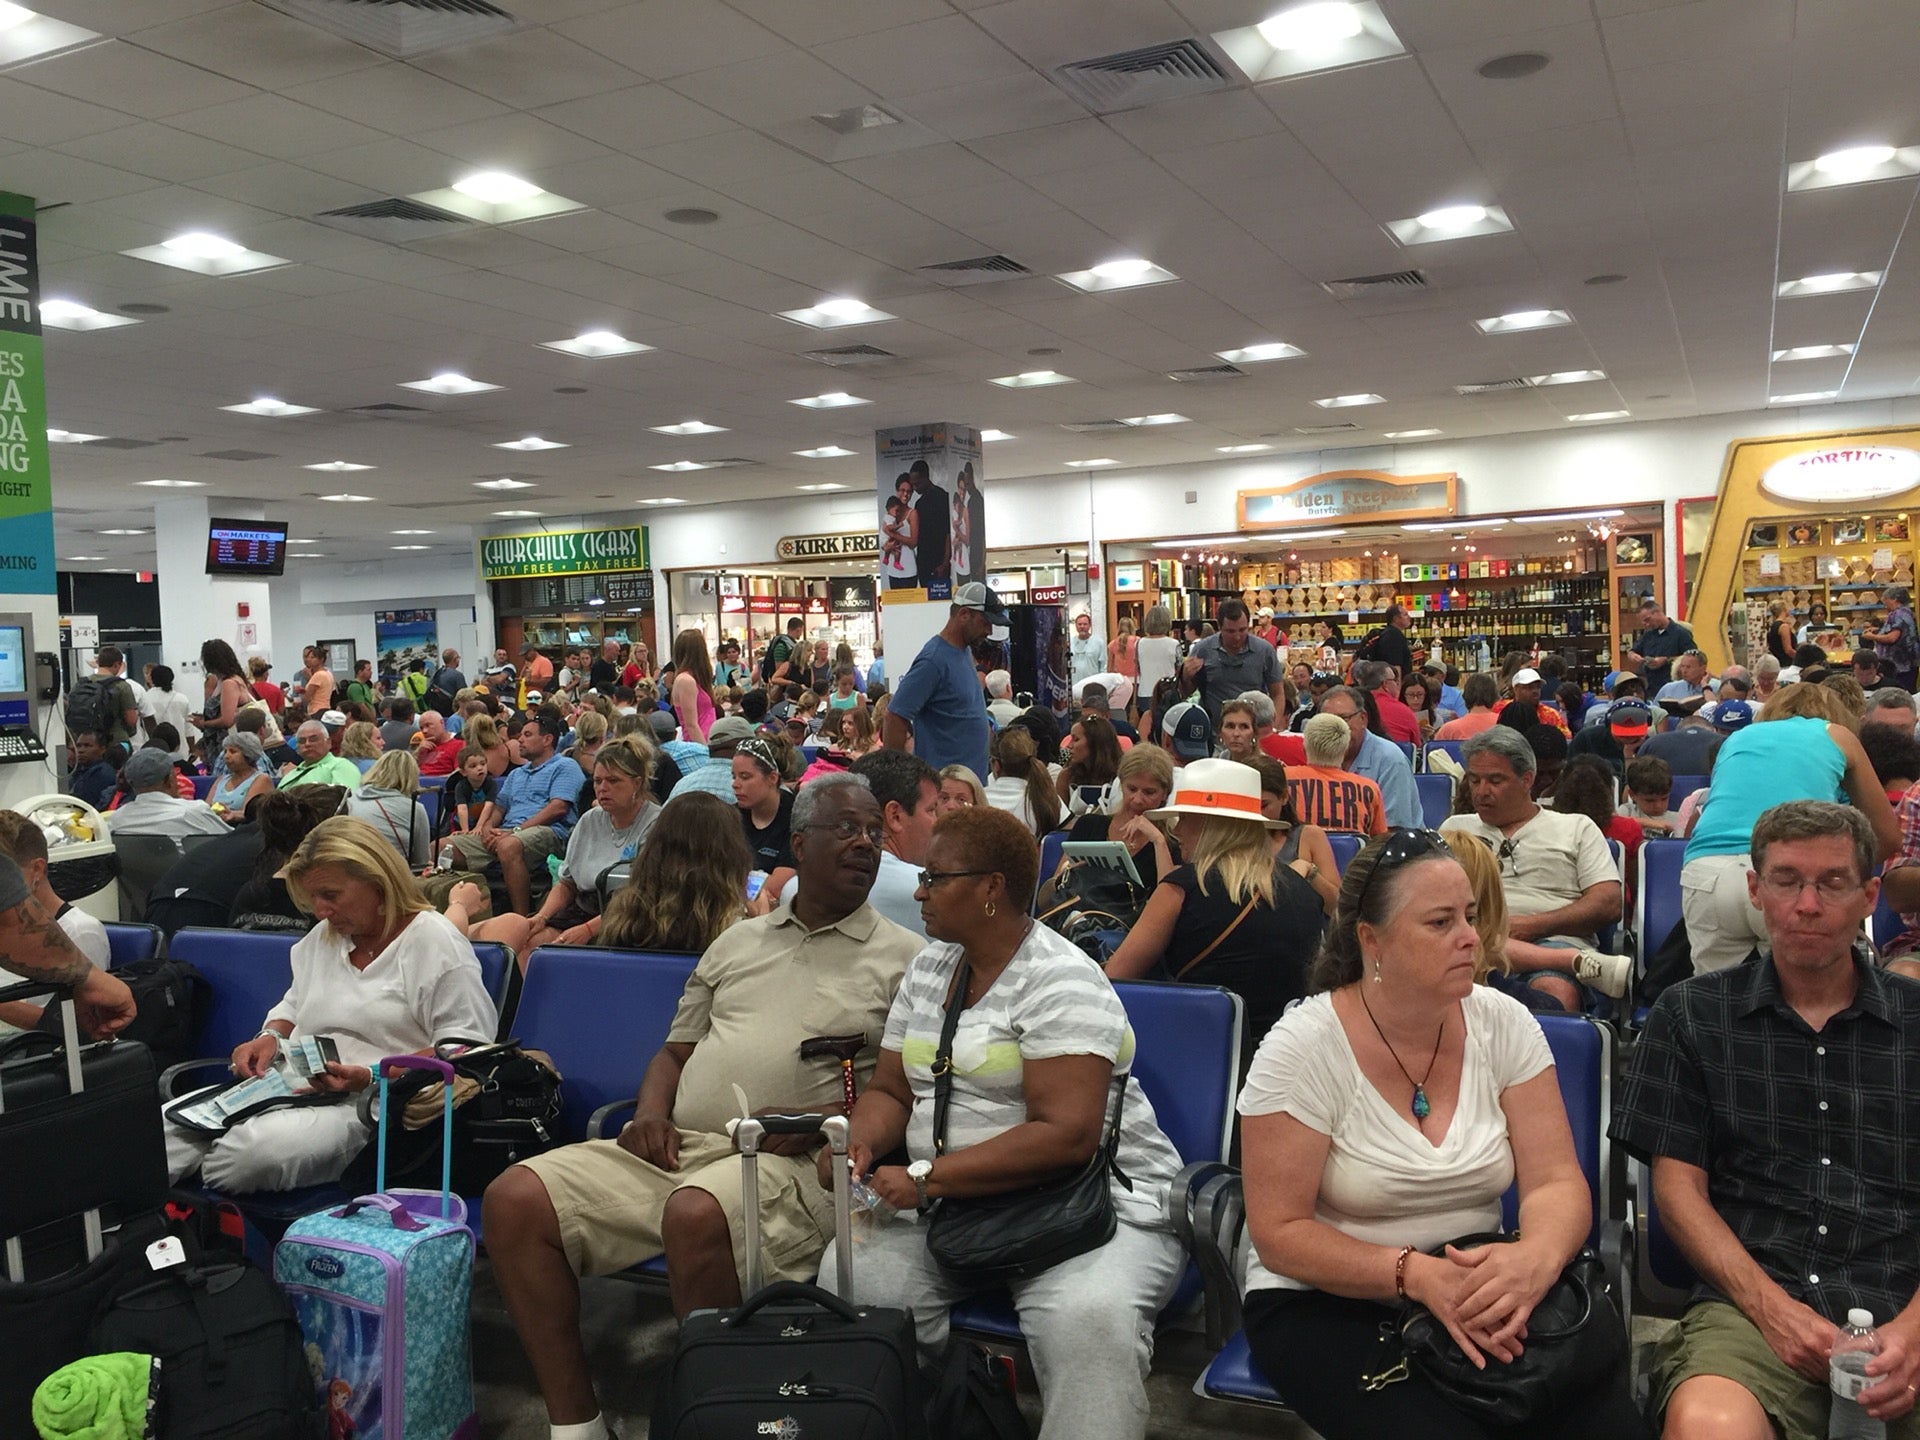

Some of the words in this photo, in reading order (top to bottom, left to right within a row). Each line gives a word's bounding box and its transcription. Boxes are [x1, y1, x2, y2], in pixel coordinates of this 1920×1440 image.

[1271, 491, 1335, 508] Bdden
[230, 532, 271, 540] MARKETS
[485, 534, 576, 565] CHURCHILL'S
[581, 529, 637, 562] CIGARS
[794, 537, 840, 556] KIRK
[486, 566, 517, 577] DUTY
[523, 563, 554, 575] FREE
[575, 561, 599, 572] TAX
[605, 557, 639, 569] FREE
[834, 600, 871, 608] SWAROVSKI
[1286, 778, 1375, 835] TYLER'S
[310, 1259, 340, 1274] FROZEN
